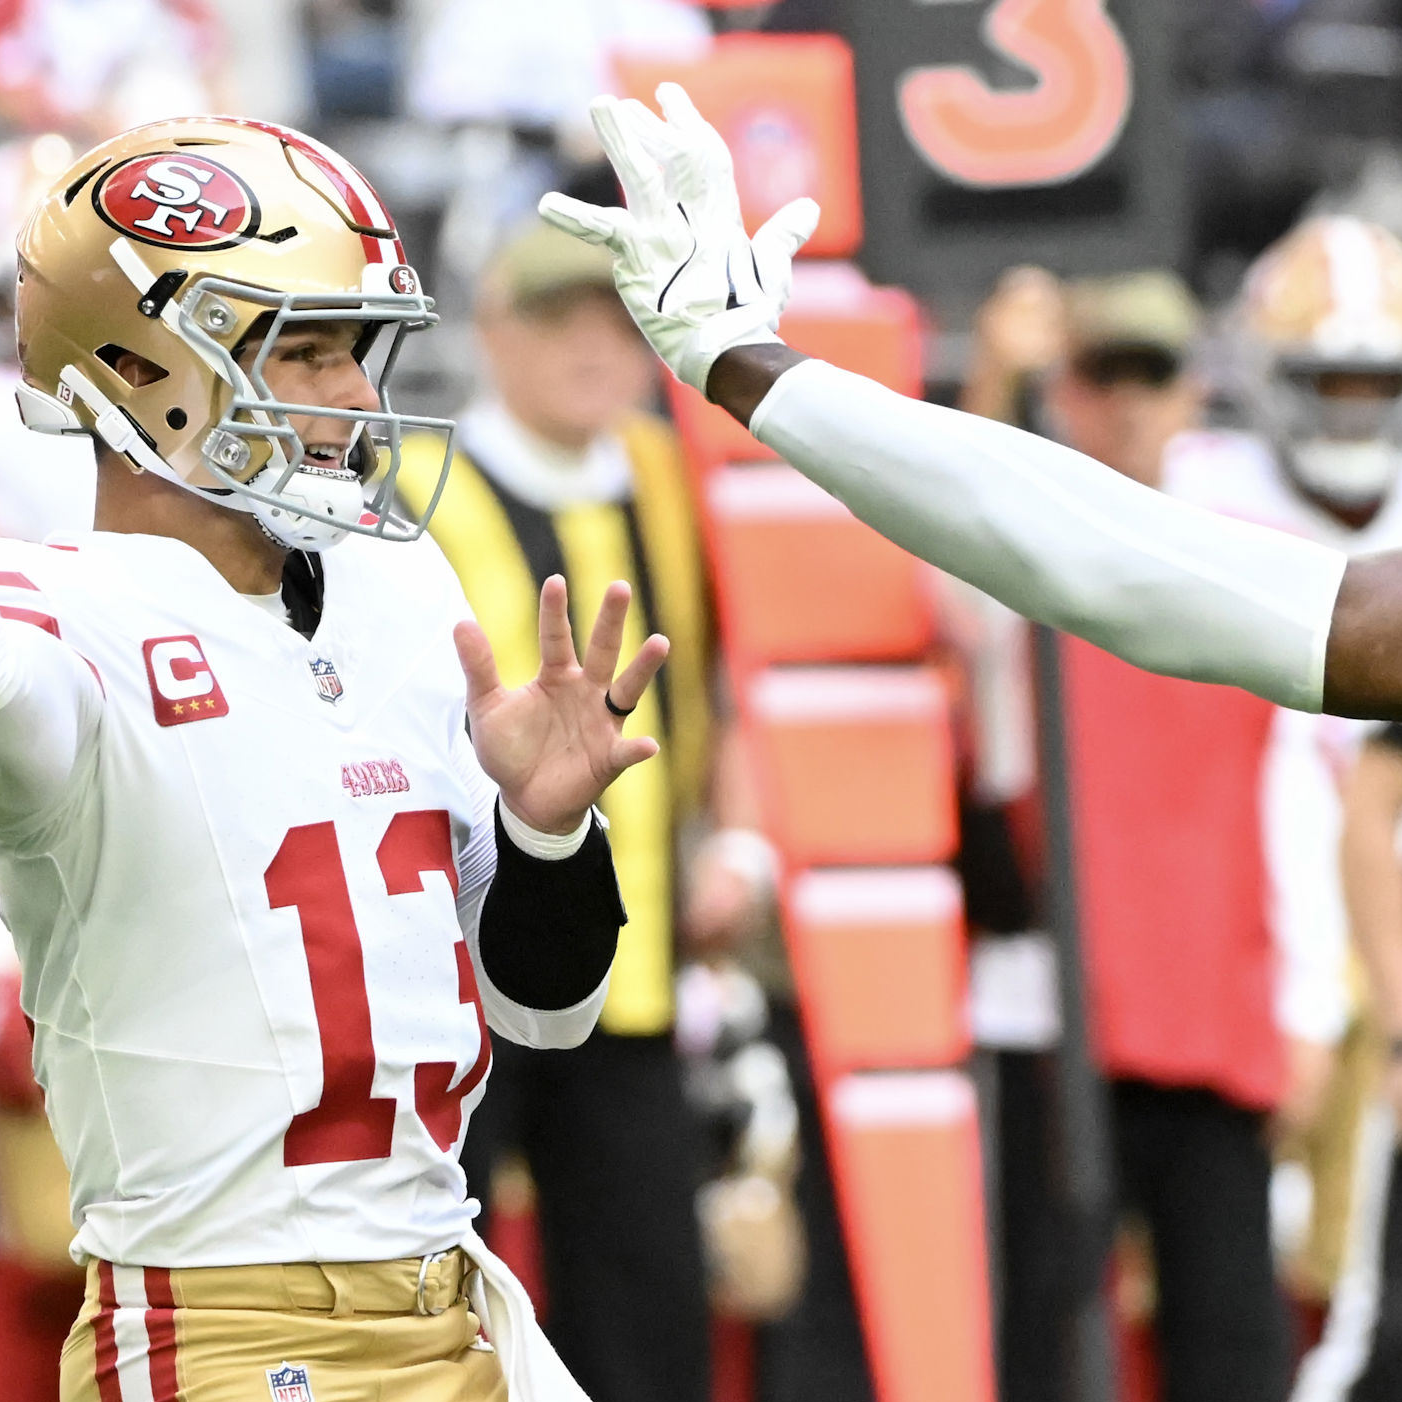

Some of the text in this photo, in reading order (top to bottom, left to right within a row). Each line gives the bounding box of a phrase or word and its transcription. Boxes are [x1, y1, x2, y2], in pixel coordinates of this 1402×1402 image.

[895, 0, 1134, 190] 3
[59, 384, 71, 402] 13
[151, 640, 214, 700] C
[341, 758, 410, 798] 49ERS
[263, 809, 493, 1168] 13
